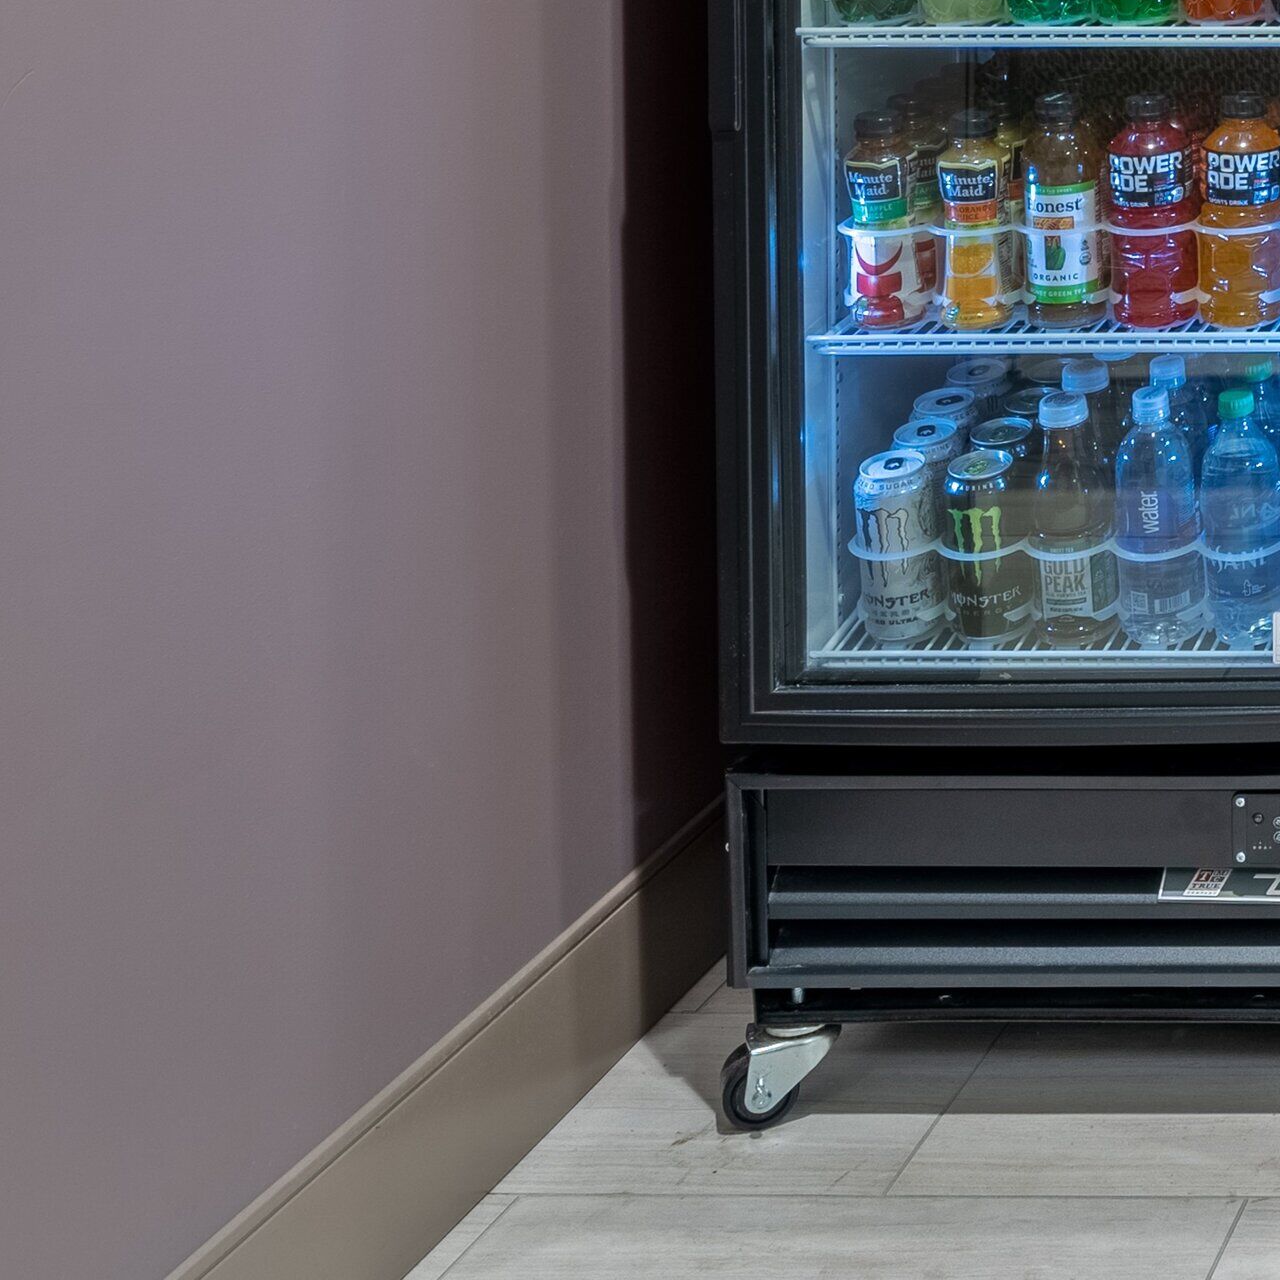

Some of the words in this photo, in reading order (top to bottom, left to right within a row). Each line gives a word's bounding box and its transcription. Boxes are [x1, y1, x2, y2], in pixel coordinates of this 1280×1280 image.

[1109, 151, 1183, 174] POWER
[1206, 150, 1280, 173] POWER
[849, 171, 893, 184] Minute
[942, 171, 993, 186] Minute
[854, 185, 890, 196] Maid
[950, 185, 986, 197] Maid
[1033, 272, 1079, 281] ORGANIC
[1044, 577, 1087, 592] PEAK
